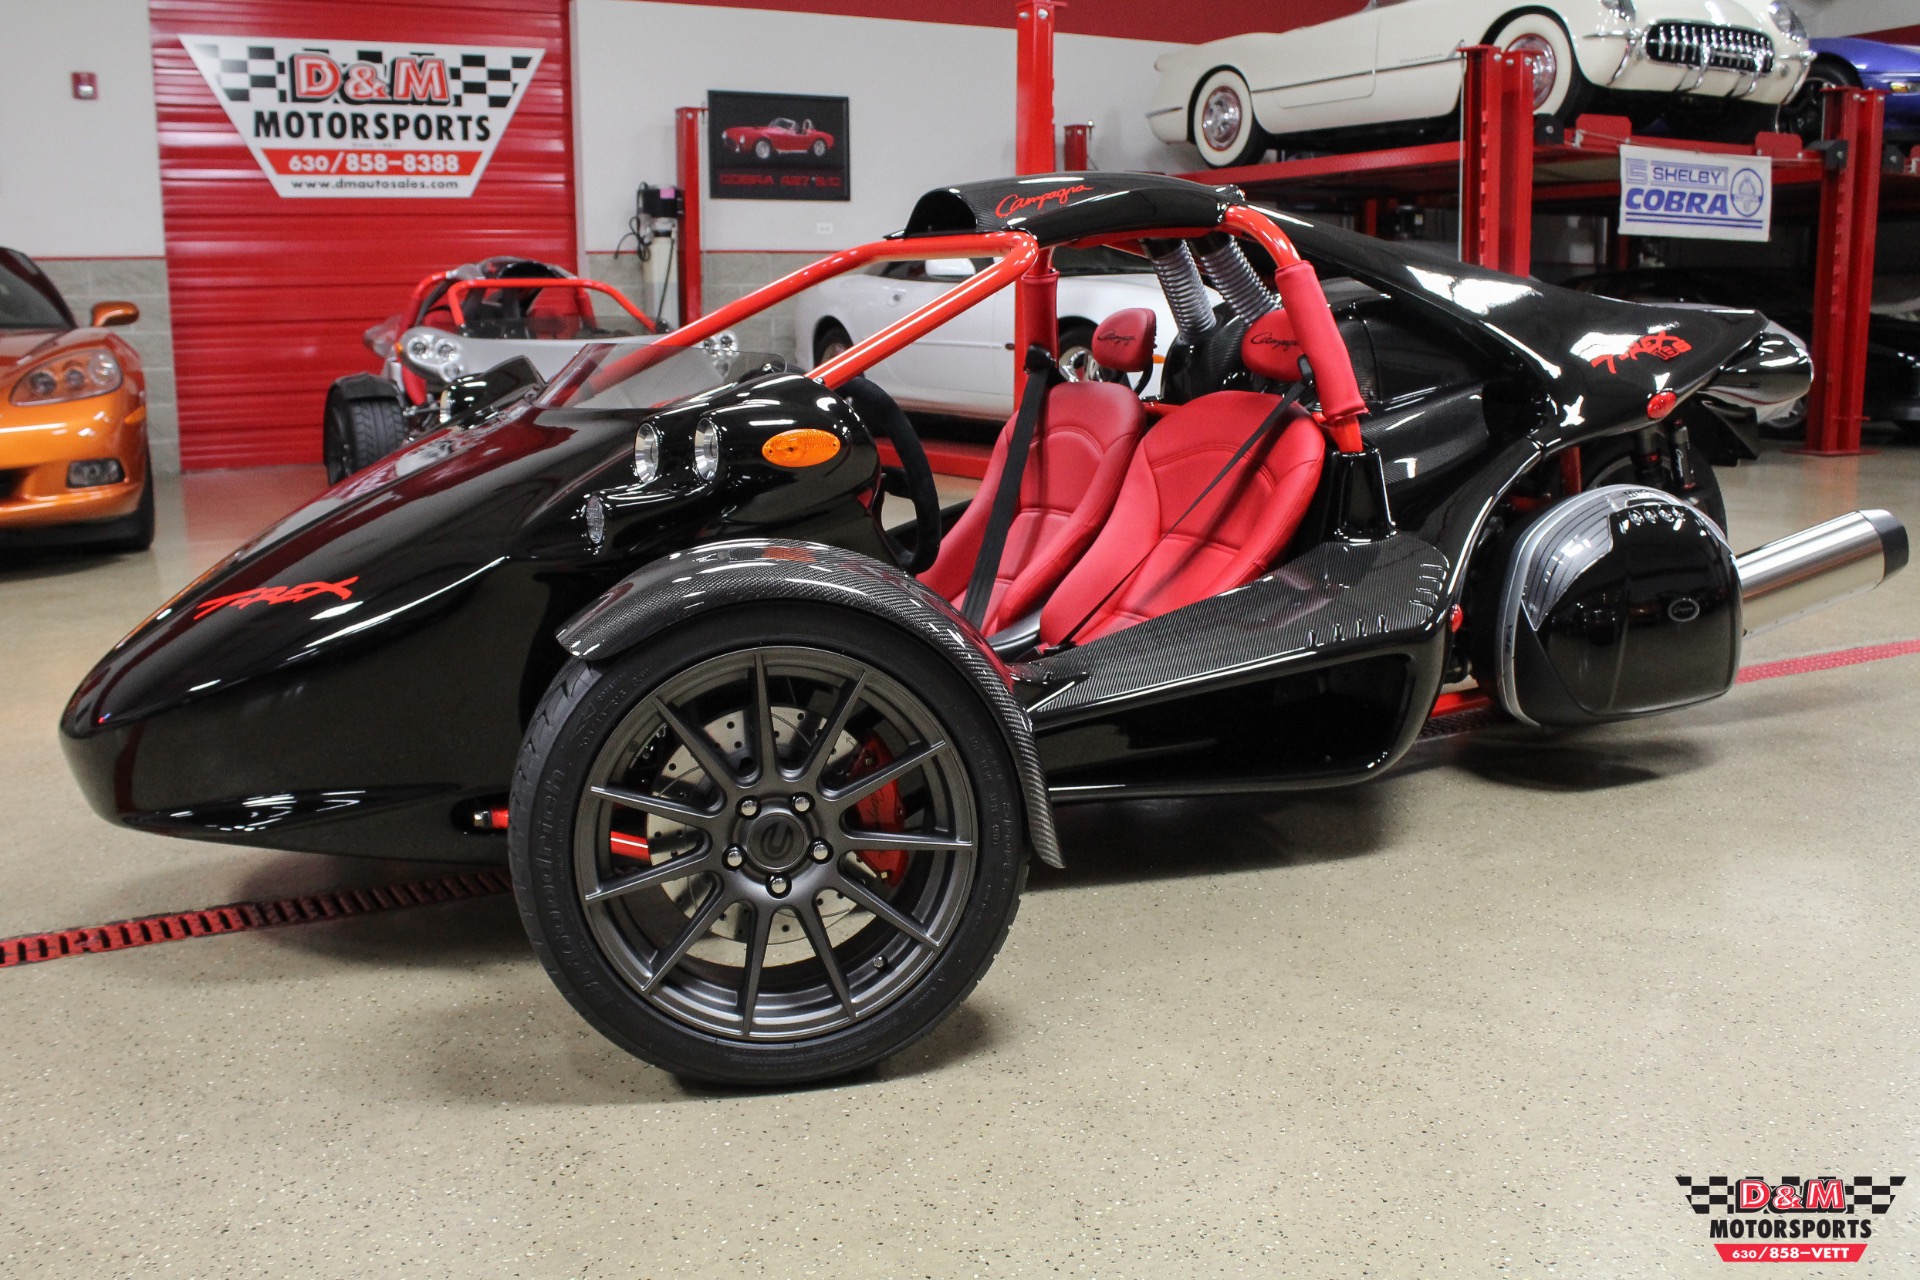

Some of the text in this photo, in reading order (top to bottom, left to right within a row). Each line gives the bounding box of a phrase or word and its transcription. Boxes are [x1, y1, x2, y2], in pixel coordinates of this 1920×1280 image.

[291, 53, 450, 104] D&M
[254, 110, 491, 142] MOTORSPORTS
[291, 178, 459, 191] www.dmautosales.com
[1653, 167, 1722, 185] SHELBY
[995, 184, 1094, 218] Campagna
[1625, 187, 1729, 216] COBRA
